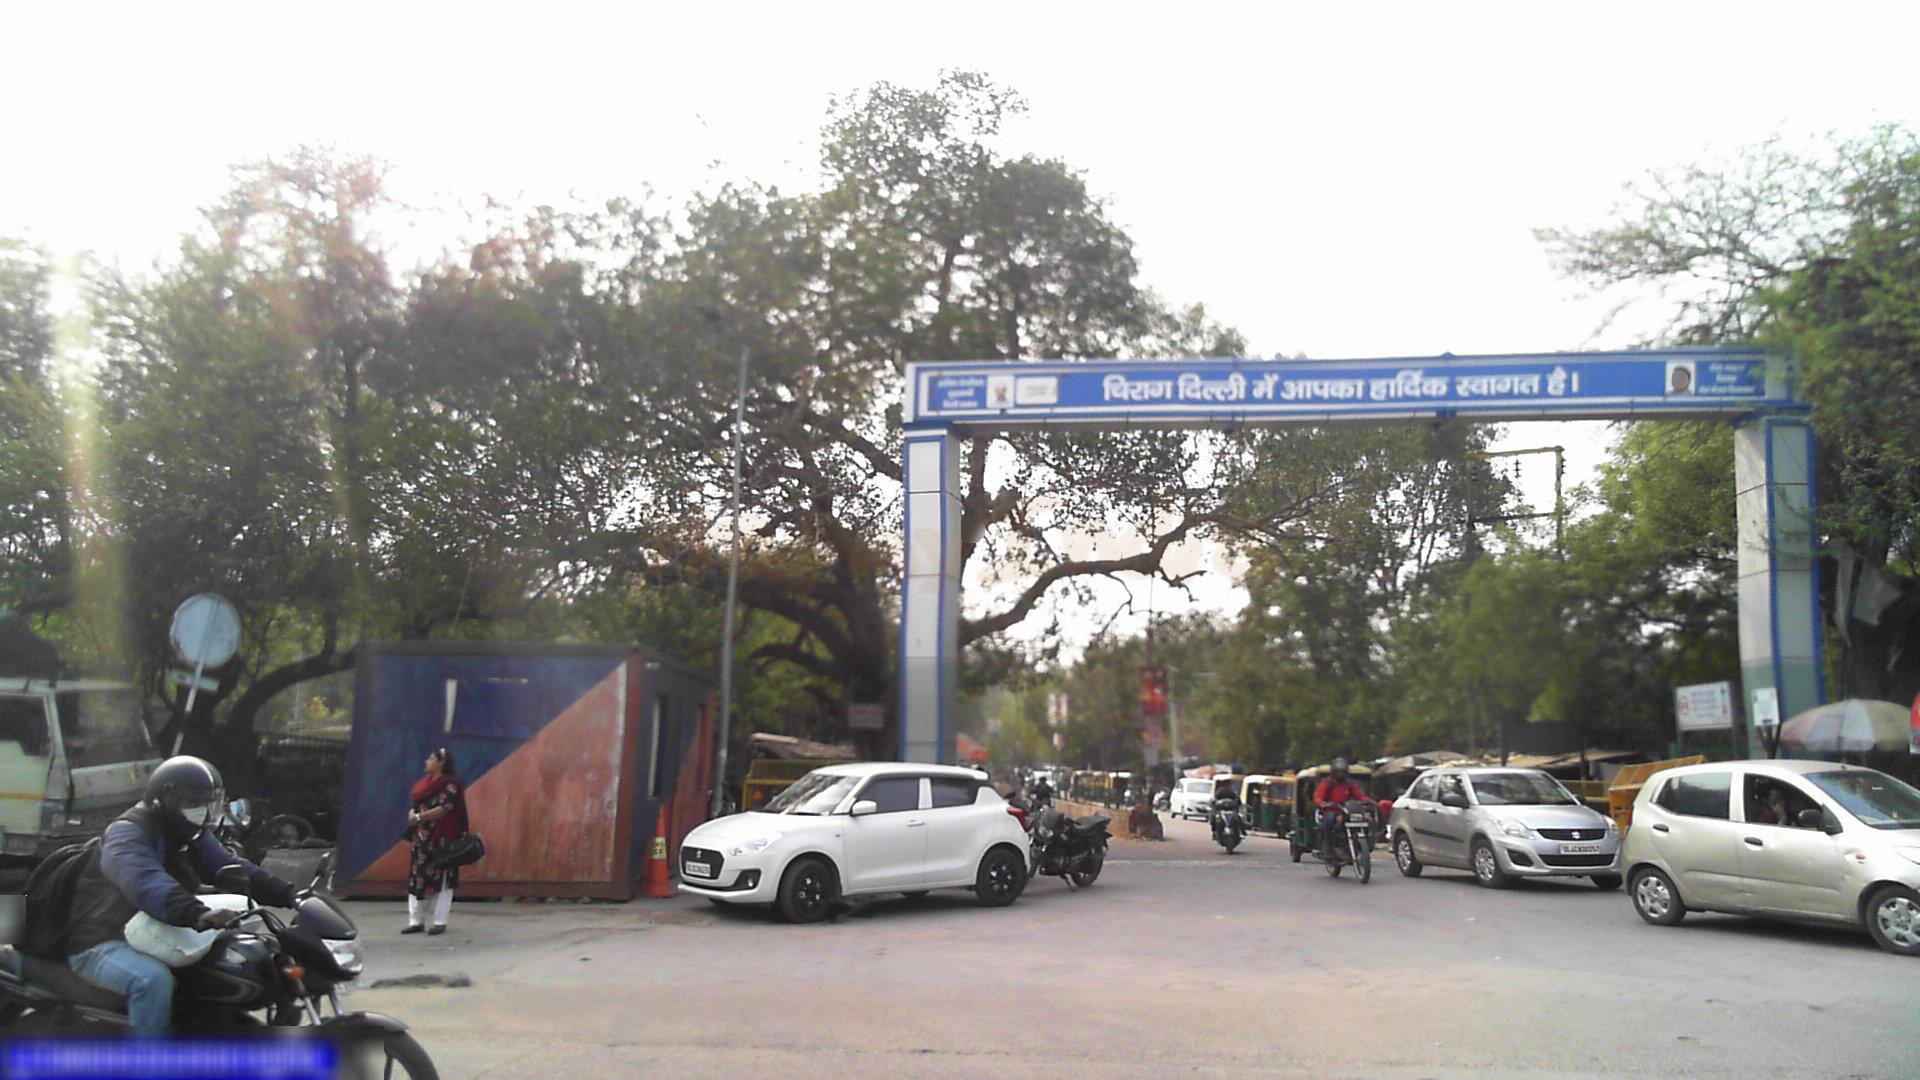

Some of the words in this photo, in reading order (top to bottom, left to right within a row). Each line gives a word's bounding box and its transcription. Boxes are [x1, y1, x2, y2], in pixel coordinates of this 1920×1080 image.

[1178, 372, 1247, 401] दिल्ली
[1252, 373, 1279, 400] में
[1281, 378, 1364, 401] आपका
[1369, 369, 1449, 401] हार्दिक
[1455, 373, 1541, 398] स्वागत
